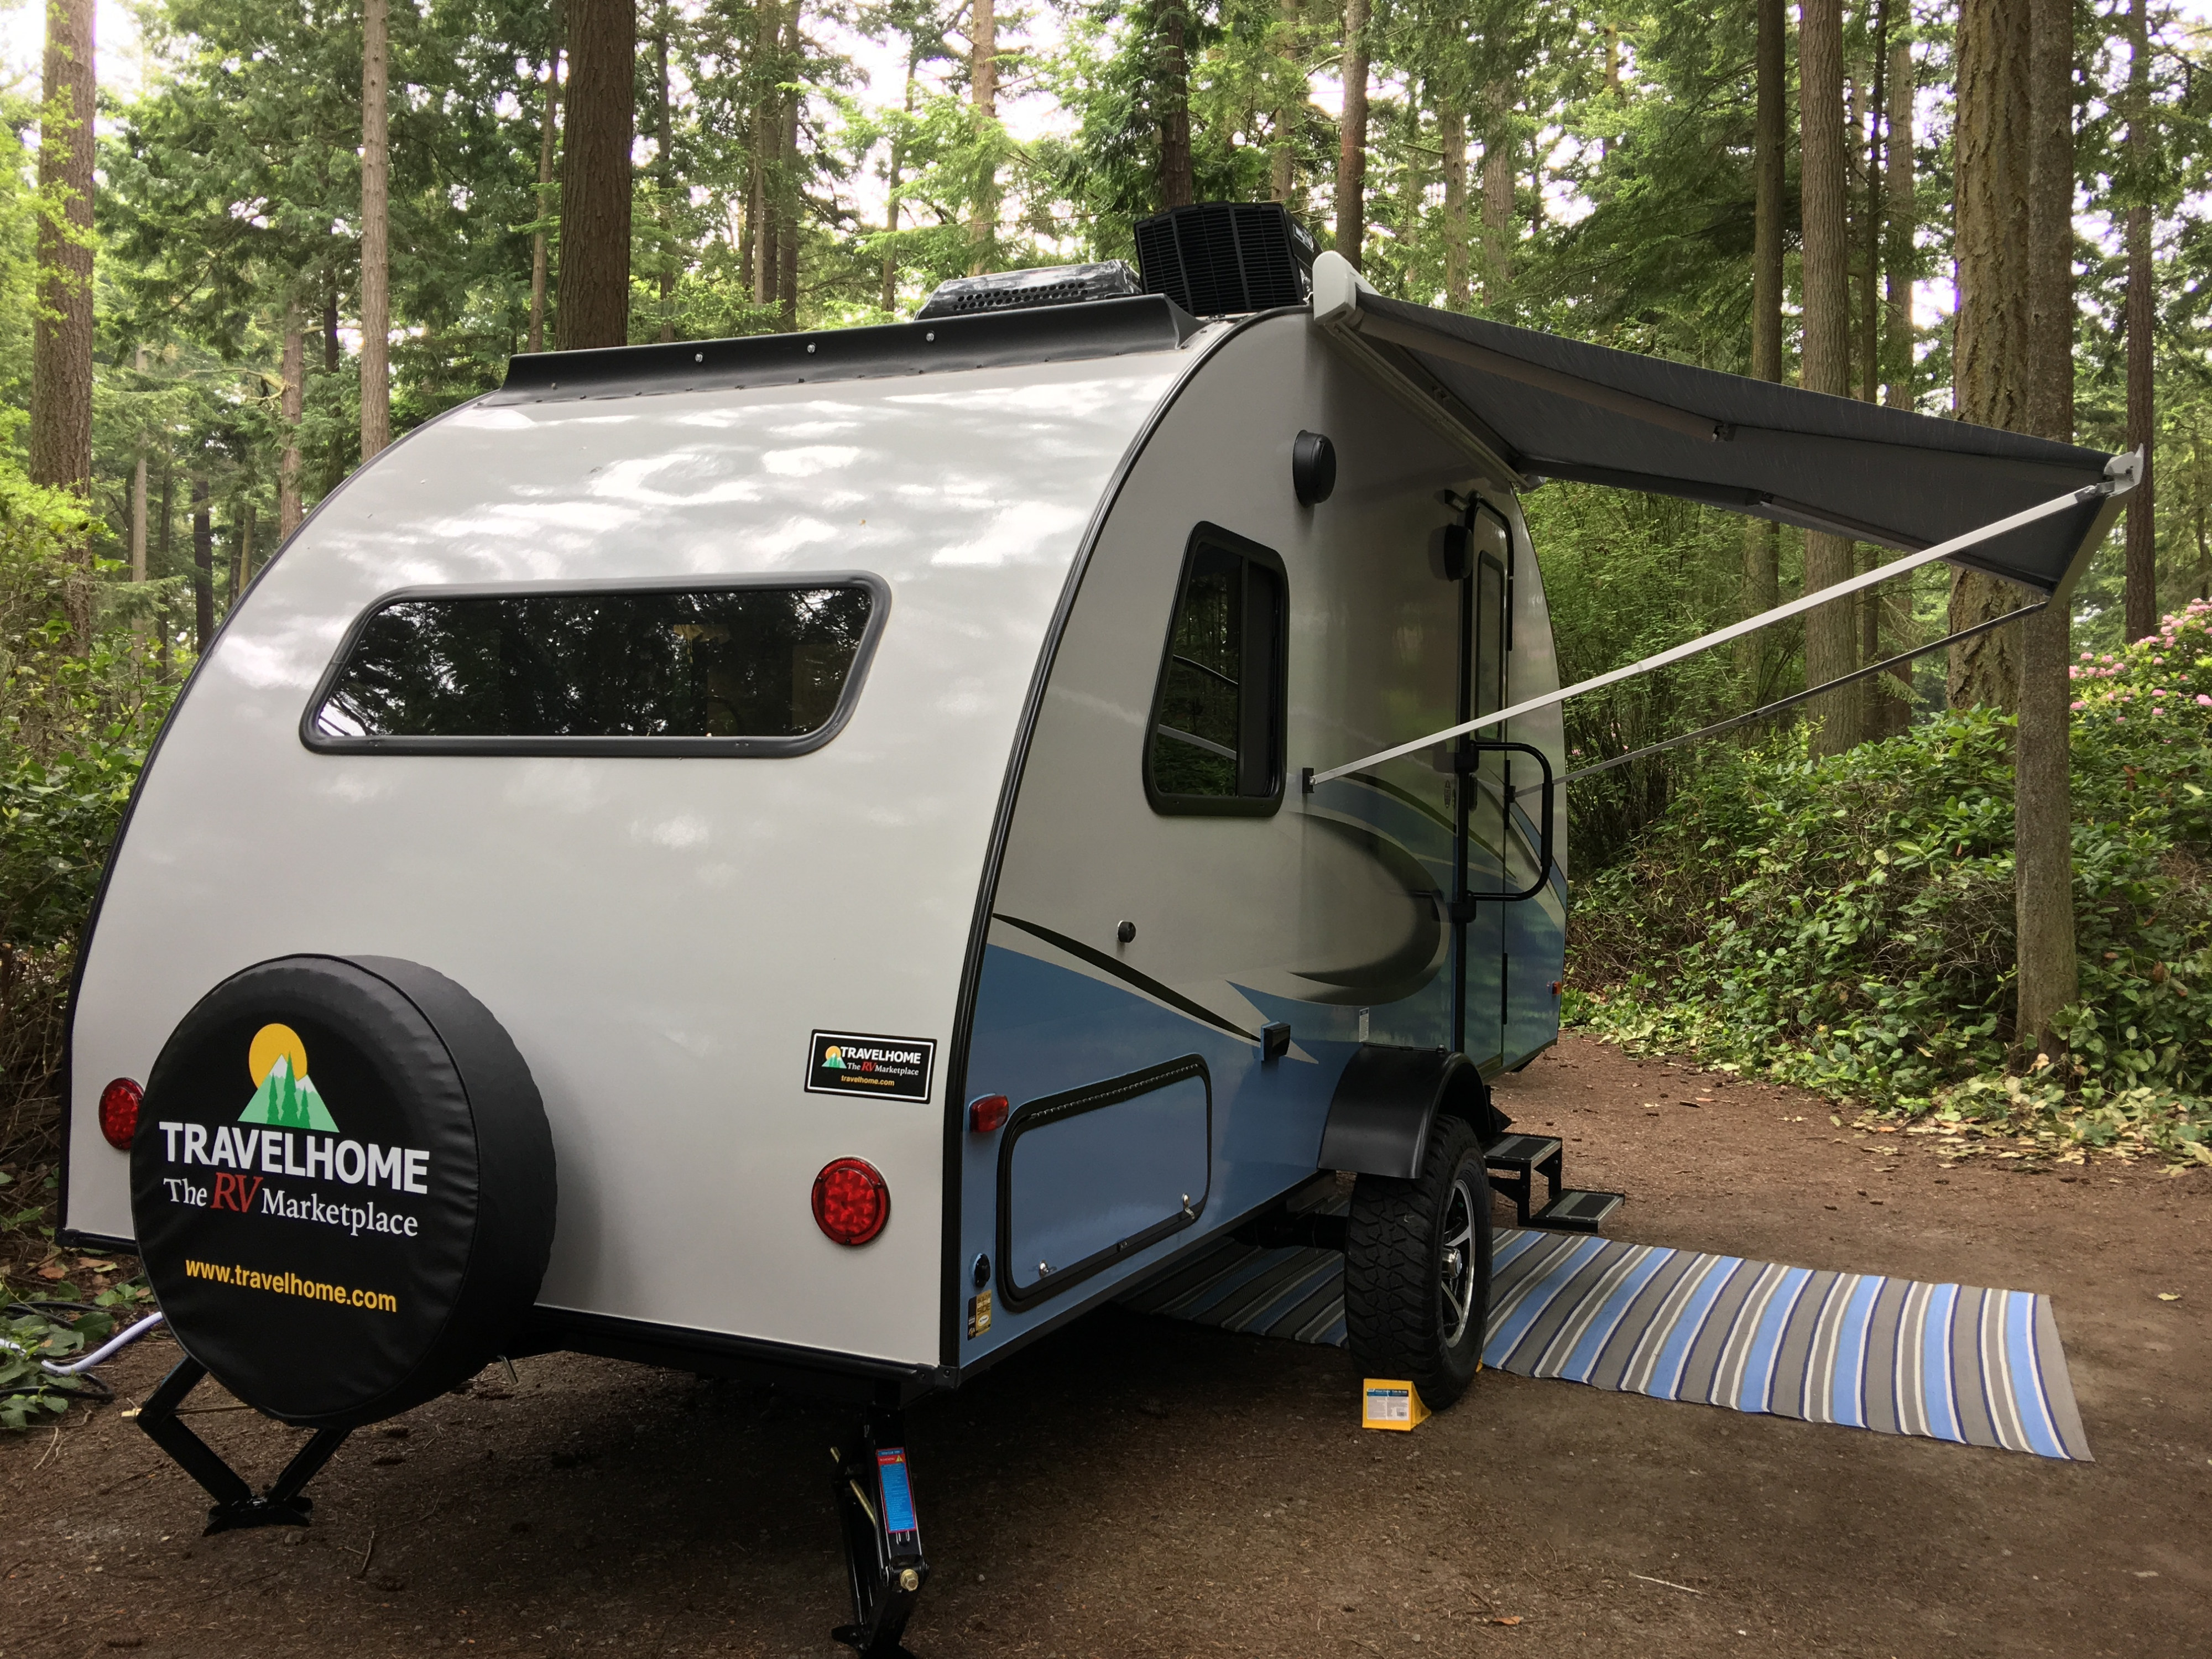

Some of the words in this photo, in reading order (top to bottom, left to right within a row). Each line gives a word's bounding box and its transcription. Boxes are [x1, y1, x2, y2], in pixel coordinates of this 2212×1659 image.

[840, 1046, 921, 1064] TRAVELHOME
[847, 1062, 861, 1071] The
[861, 1061, 877, 1072] RV
[875, 1064, 919, 1076] Marketplace
[841, 1075, 895, 1086] travelhome.com
[159, 1121, 430, 1194] TRAVELHOME
[163, 1178, 207, 1207] The
[210, 1172, 263, 1213] RV
[261, 1187, 418, 1237] Marketplace
[185, 1260, 397, 1312] www.travelhome.com
[977, 1303, 990, 1315] SIDE
